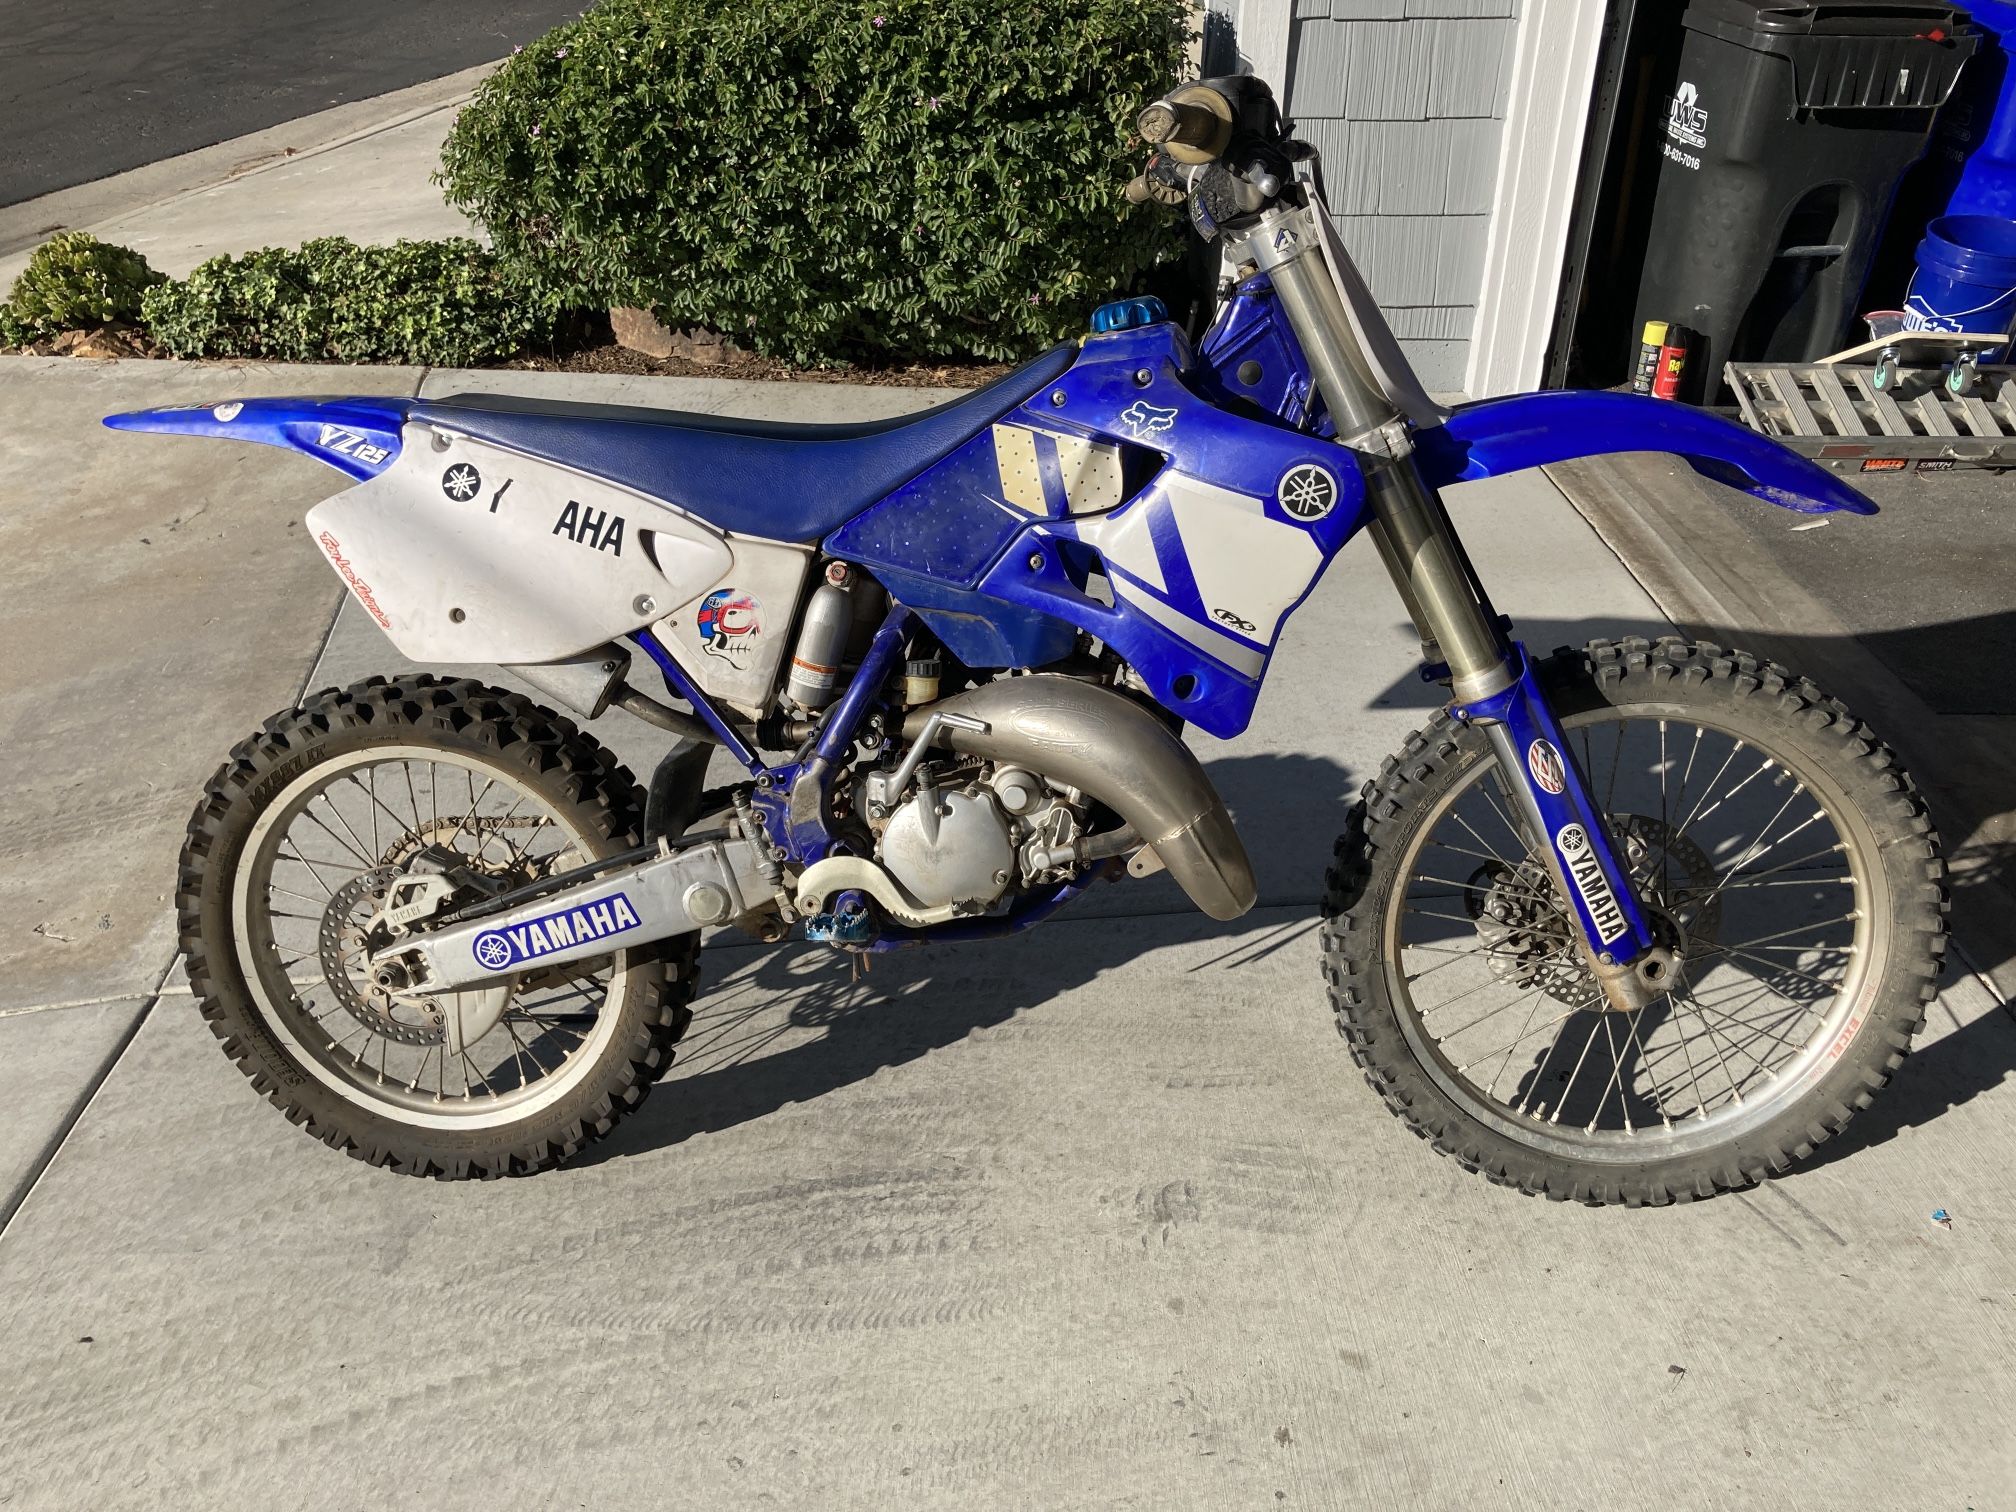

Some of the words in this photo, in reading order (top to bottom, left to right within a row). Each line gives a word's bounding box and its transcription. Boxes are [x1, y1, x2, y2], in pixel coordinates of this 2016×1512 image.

[1571, 849, 1626, 941] YAMAHA
[506, 898, 639, 958] YAMAHA
[1828, 1016, 1860, 1059] EXCEL
